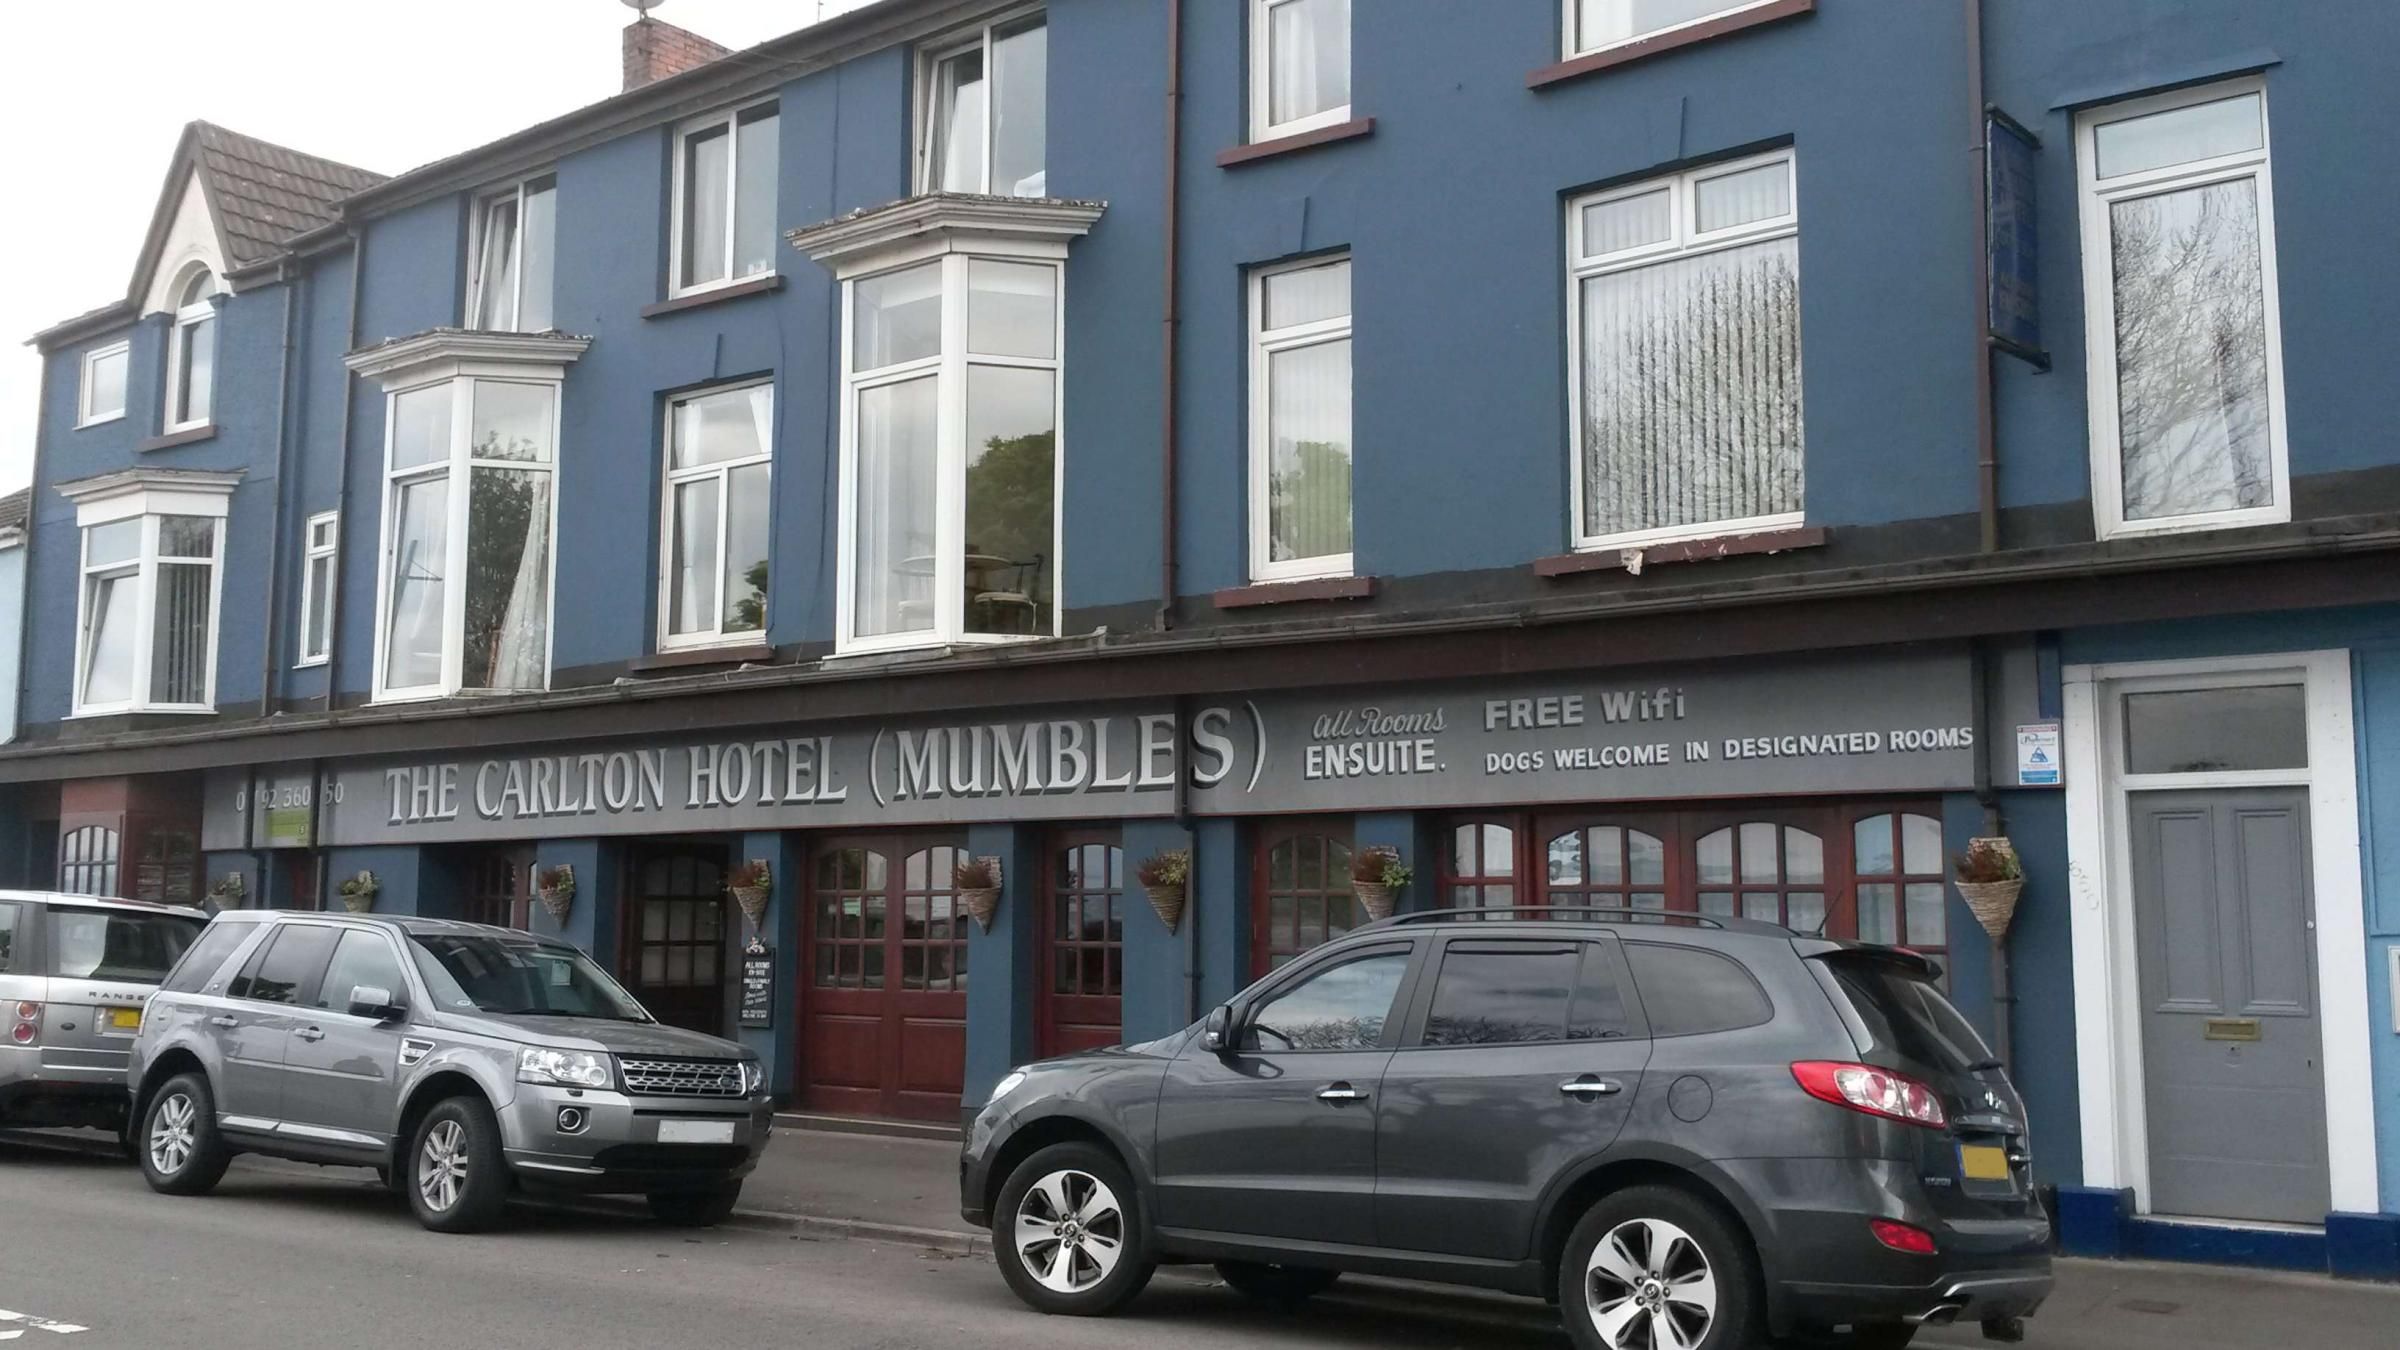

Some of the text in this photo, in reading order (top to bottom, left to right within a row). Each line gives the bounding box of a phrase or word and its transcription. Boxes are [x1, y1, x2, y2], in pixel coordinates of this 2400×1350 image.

[1355, 706, 1448, 736] Rooms
[1484, 687, 1686, 730] FREE Wifi
[386, 699, 1267, 823] THE CARLTON HOTEL (MUMBLES)
[1485, 726, 1974, 774] DOGS WELCOME IN DESIGNATED ROOMS
[88, 991, 146, 1001] RANGE
